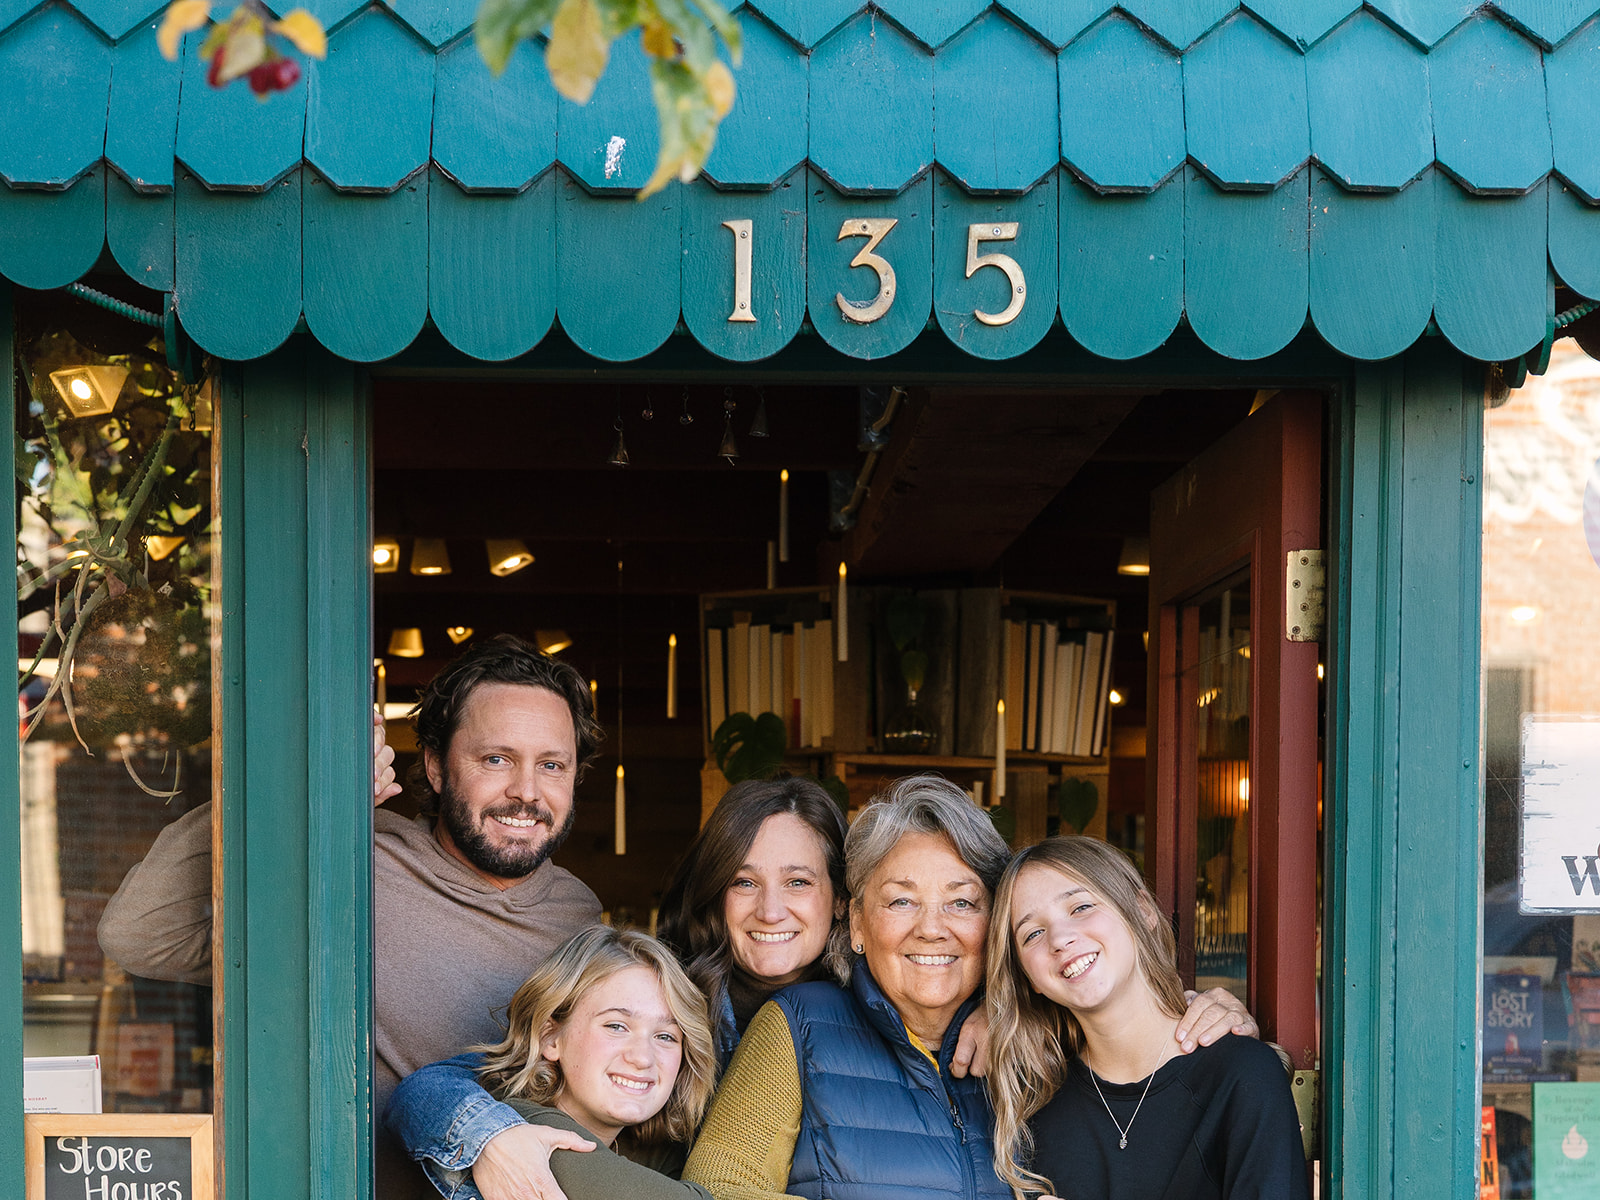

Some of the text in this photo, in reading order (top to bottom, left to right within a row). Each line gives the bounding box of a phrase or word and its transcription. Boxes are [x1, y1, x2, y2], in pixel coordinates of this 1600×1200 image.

[721, 218, 1026, 325] 135
[1491, 992, 1530, 1012] LOST
[1487, 1010, 1534, 1028] STORY
[56, 1136, 153, 1175] Store
